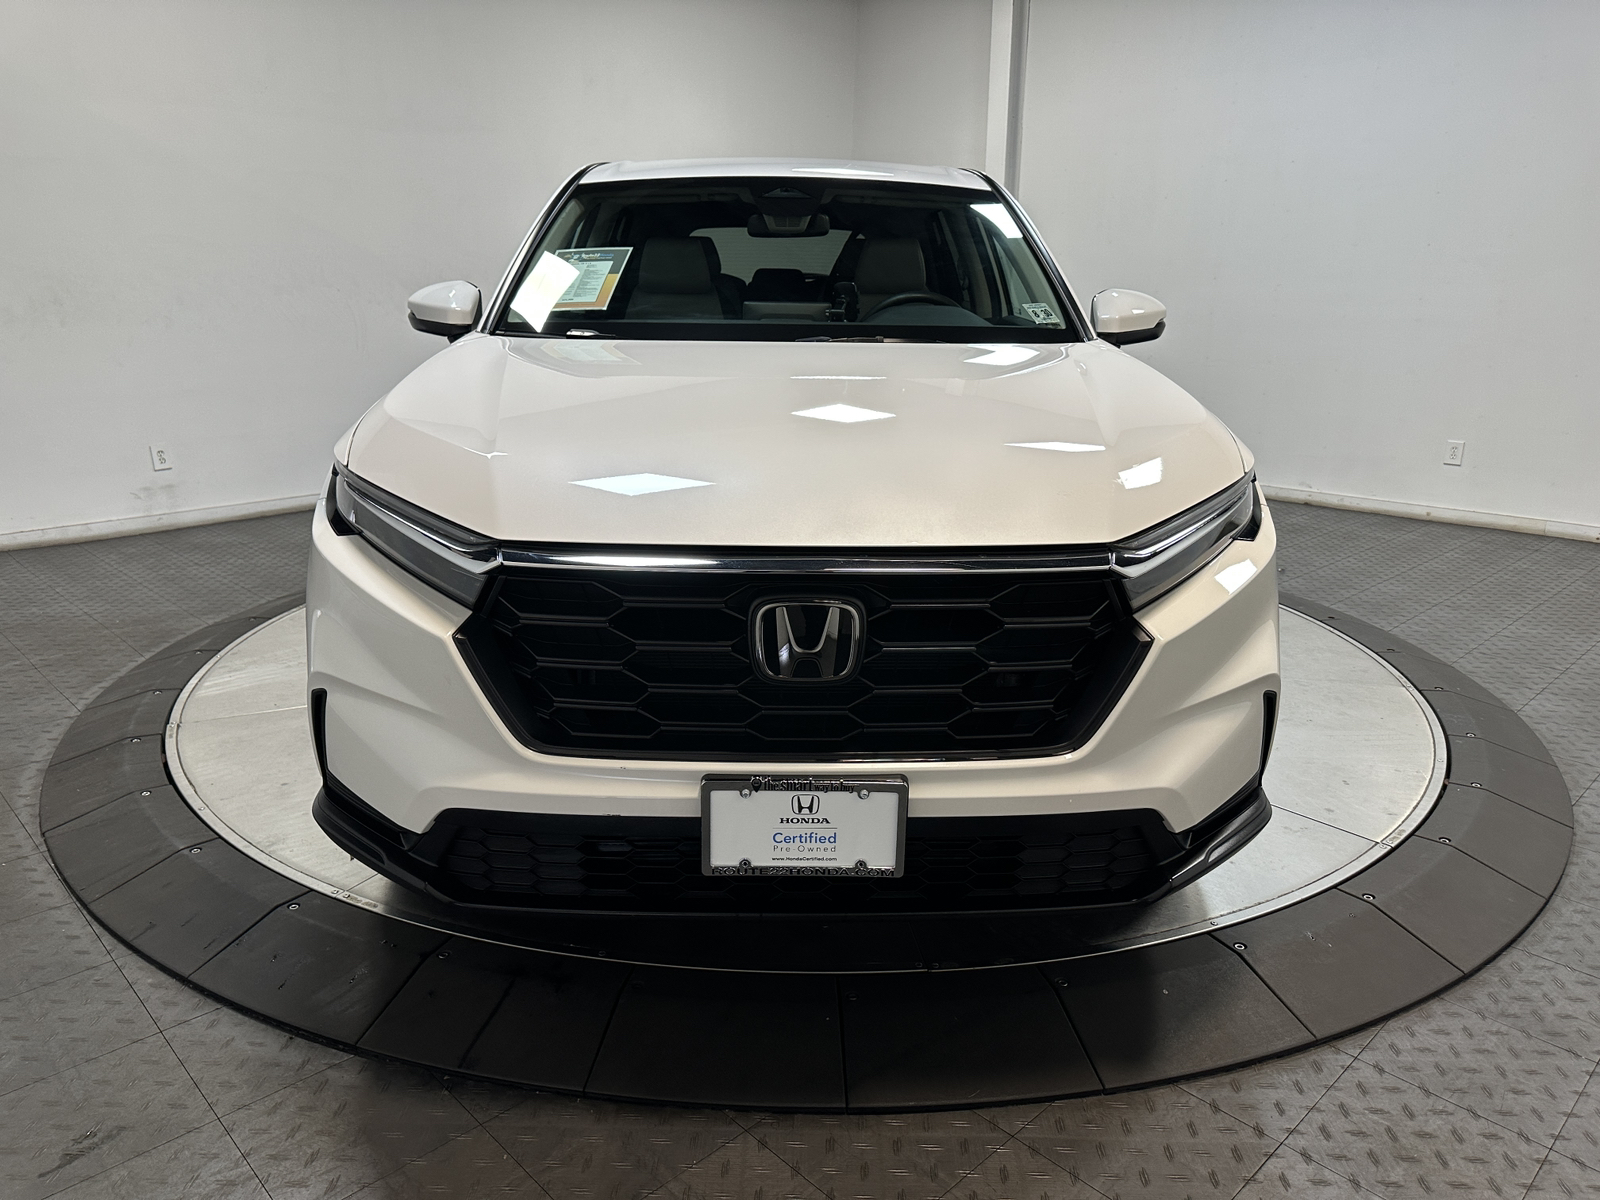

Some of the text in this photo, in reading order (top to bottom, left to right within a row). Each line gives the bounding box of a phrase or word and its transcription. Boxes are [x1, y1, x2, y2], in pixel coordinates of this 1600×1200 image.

[780, 779, 813, 791] smart
[772, 832, 837, 844] Certified
[711, 867, 895, 877] ROUTE22HONDA.COM
